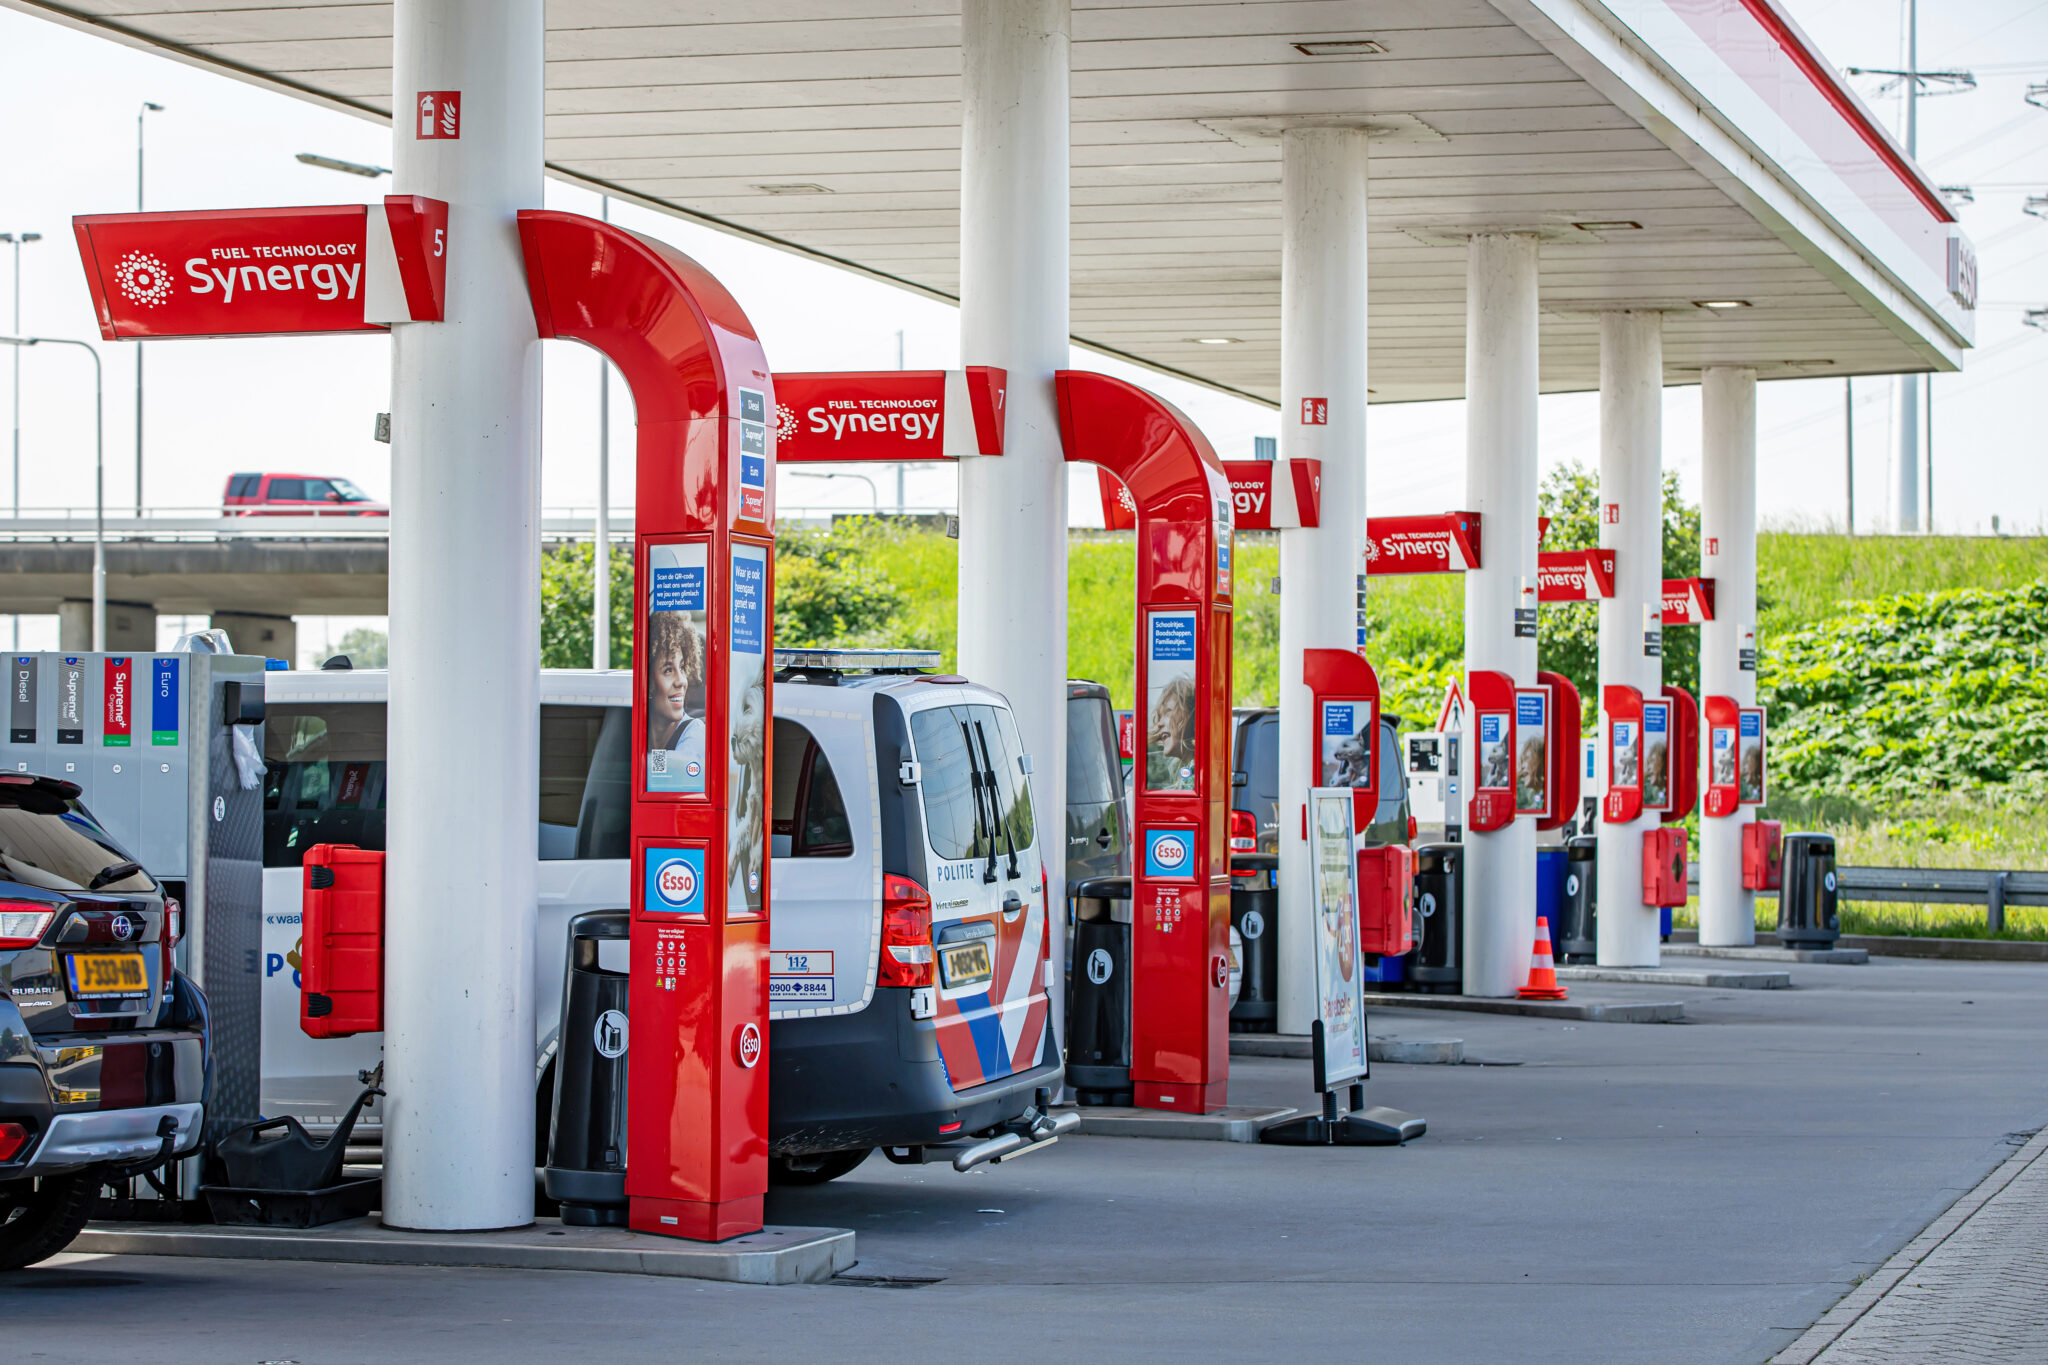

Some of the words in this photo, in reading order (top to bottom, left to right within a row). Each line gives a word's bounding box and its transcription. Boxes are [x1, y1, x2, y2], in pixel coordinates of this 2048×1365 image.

[433, 229, 443, 257] 5
[211, 247, 250, 260] FUEL
[252, 244, 357, 258] TECHNOLOGY
[185, 258, 361, 303] Synergy
[828, 400, 858, 409] FUEL
[859, 399, 938, 409] TECHNOLOGY
[998, 389, 1004, 409] 7
[807, 407, 940, 440] Synergy
[1314, 475, 1320, 492] 9
[1408, 532, 1449, 540] TECHNOLOGY
[735, 565, 745, 578] Waar
[746, 567, 751, 581] je
[752, 568, 760, 580] ook
[1602, 560, 1613, 573] 13
[1538, 573, 1587, 590] ynerg
[681, 590, 699, 598] glimlach
[656, 599, 674, 607] bezorgd
[19, 670, 29, 703] Diesel
[161, 672, 171, 698] Euro
[67, 671, 79, 724] Supreme+
[113, 672, 127, 728] Supreme+
[1429, 755, 1438, 766] 13
[1158, 844, 1182, 858] Esso
[937, 863, 974, 881] POLITIE
[662, 871, 692, 891] Esso
[11, 987, 56, 996] SUBARU
[770, 983, 791, 992] 0900
[803, 983, 826, 992] 8844
[743, 1035, 758, 1053] Esso
